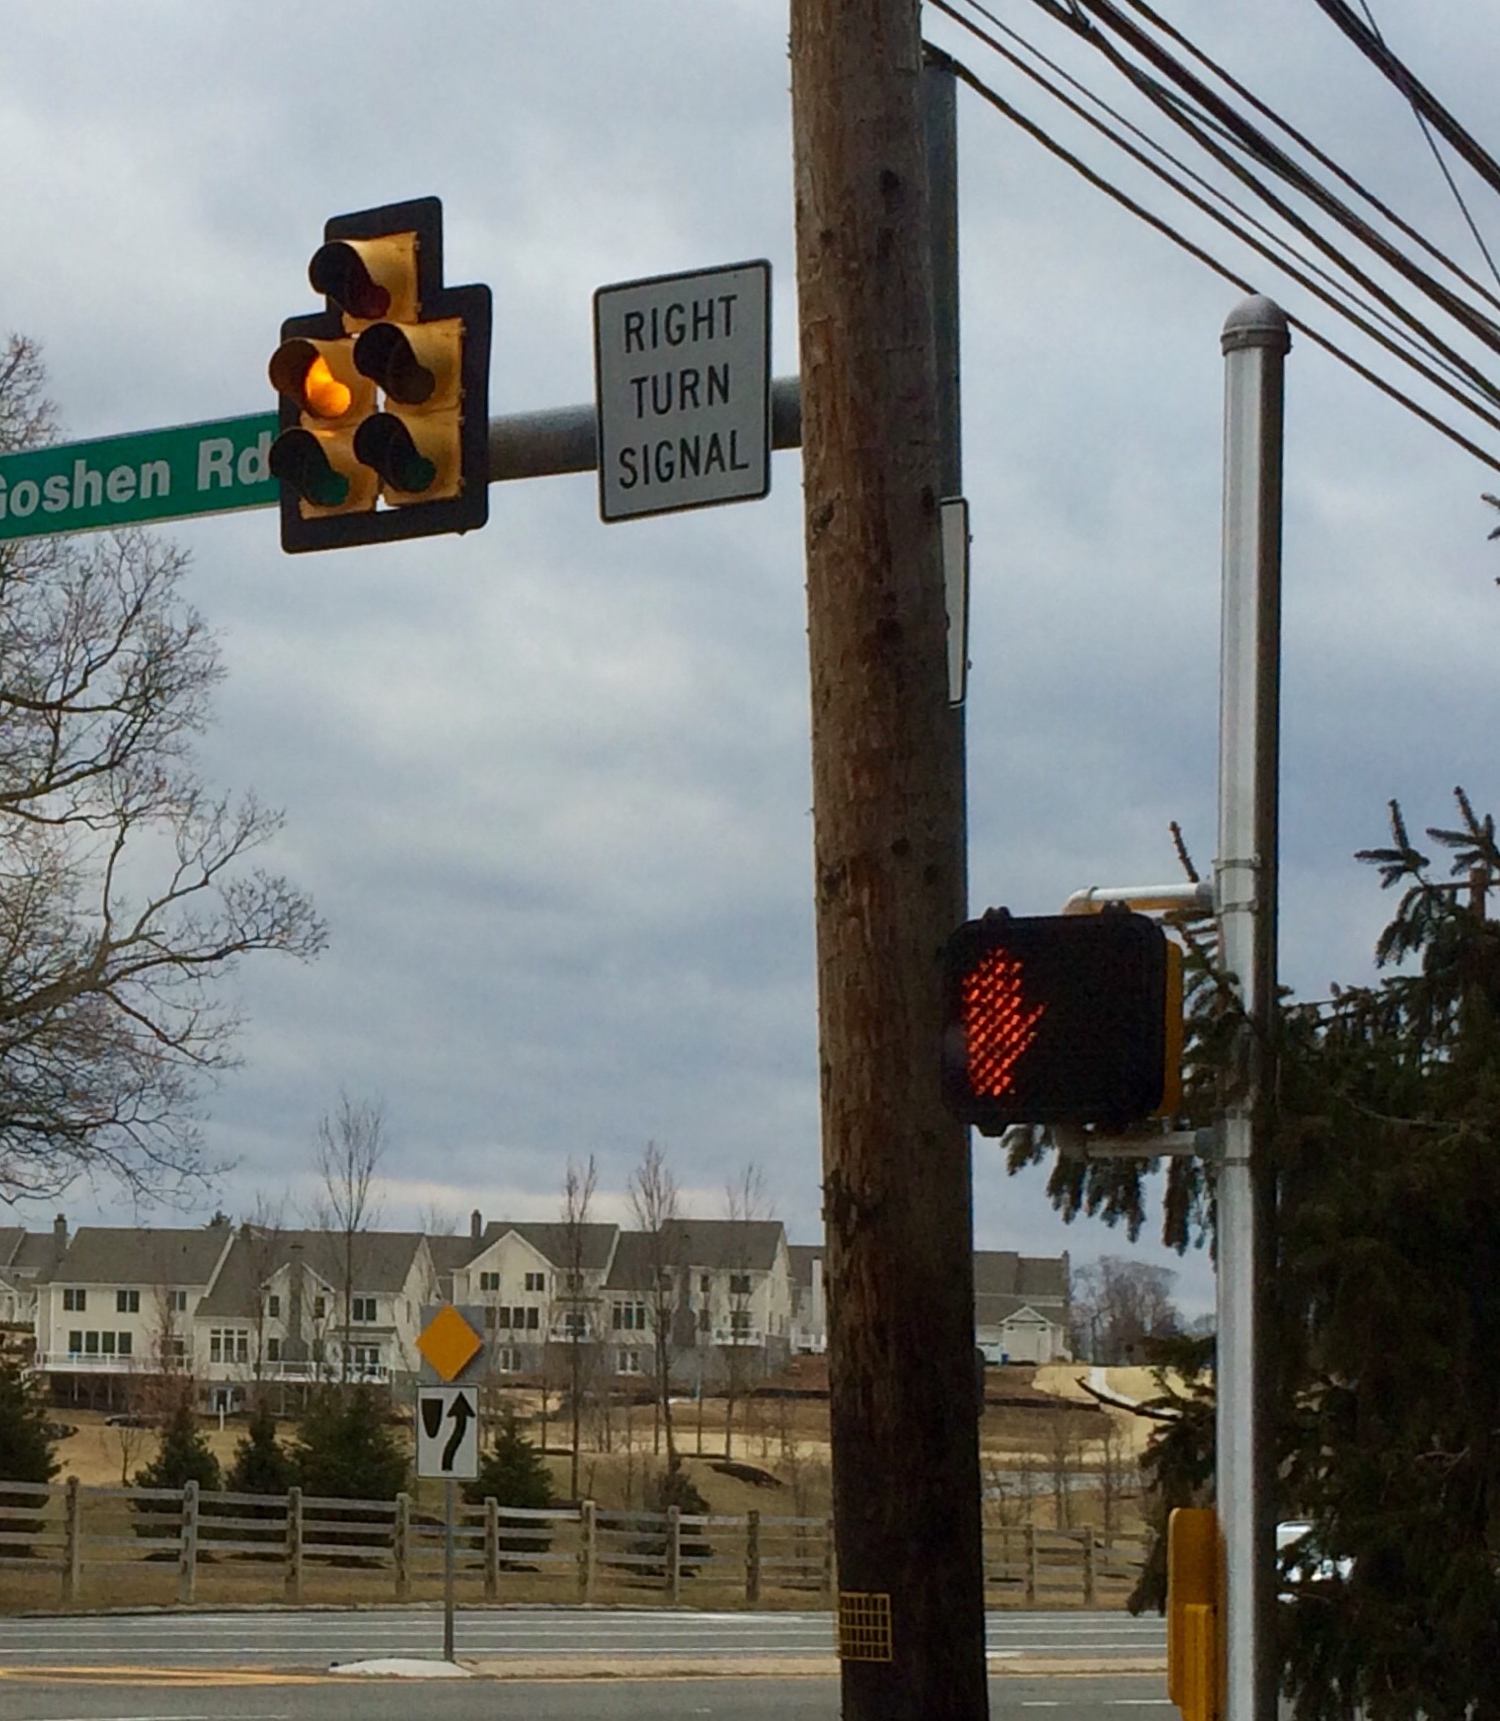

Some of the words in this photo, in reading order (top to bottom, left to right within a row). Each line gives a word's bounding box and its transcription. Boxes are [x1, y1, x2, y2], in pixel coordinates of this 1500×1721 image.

[624, 294, 738, 353] RIGHT
[630, 363, 729, 419] TURN
[197, 430, 273, 491] Rd
[619, 429, 749, 489] SIGNAL
